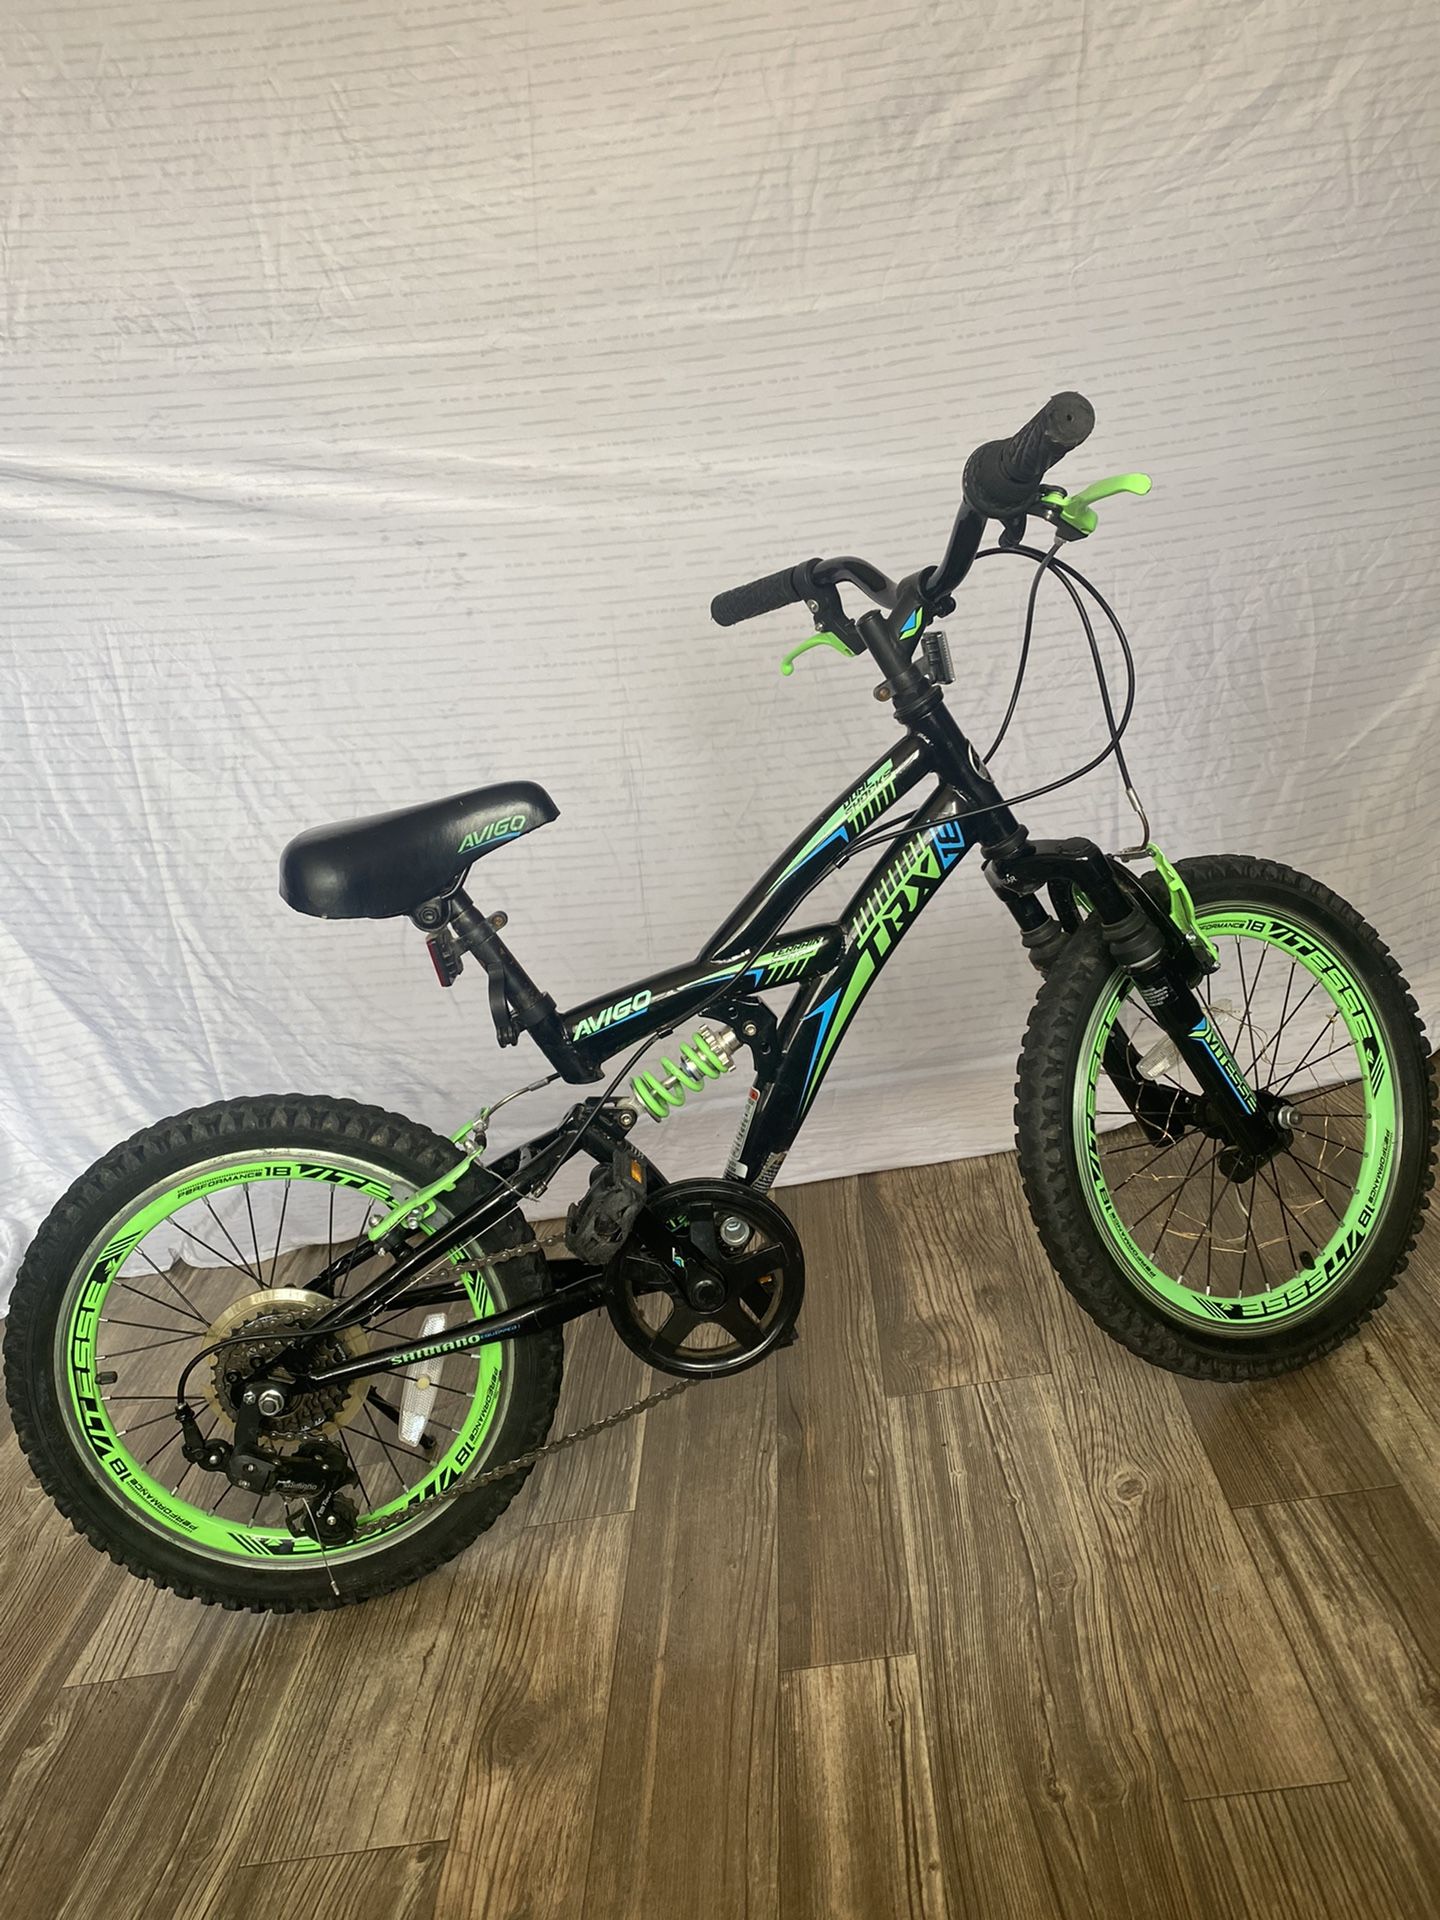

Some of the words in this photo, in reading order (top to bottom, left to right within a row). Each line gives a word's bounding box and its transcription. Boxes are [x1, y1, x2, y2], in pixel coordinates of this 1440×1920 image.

[458, 815, 526, 853] AVIGO
[1246, 919, 1265, 932] 18
[1268, 921, 1372, 1039] VITESSE
[573, 990, 652, 1041] AVIGO
[1206, 1032, 1257, 1113] VITESSE
[177, 1172, 262, 1199] PERFORMANCE
[264, 1166, 292, 1177] 18
[1358, 1204, 1375, 1228] 18
[1242, 1229, 1365, 1318] VITESSE
[73, 1281, 116, 1461] VITESSE
[390, 1334, 481, 1366] SHIMANO
[469, 1367, 499, 1443] PERFORMANCE
[110, 1457, 132, 1483] 18
[455, 1442, 475, 1467] 18
[131, 1480, 199, 1532] PERFORMANCE
